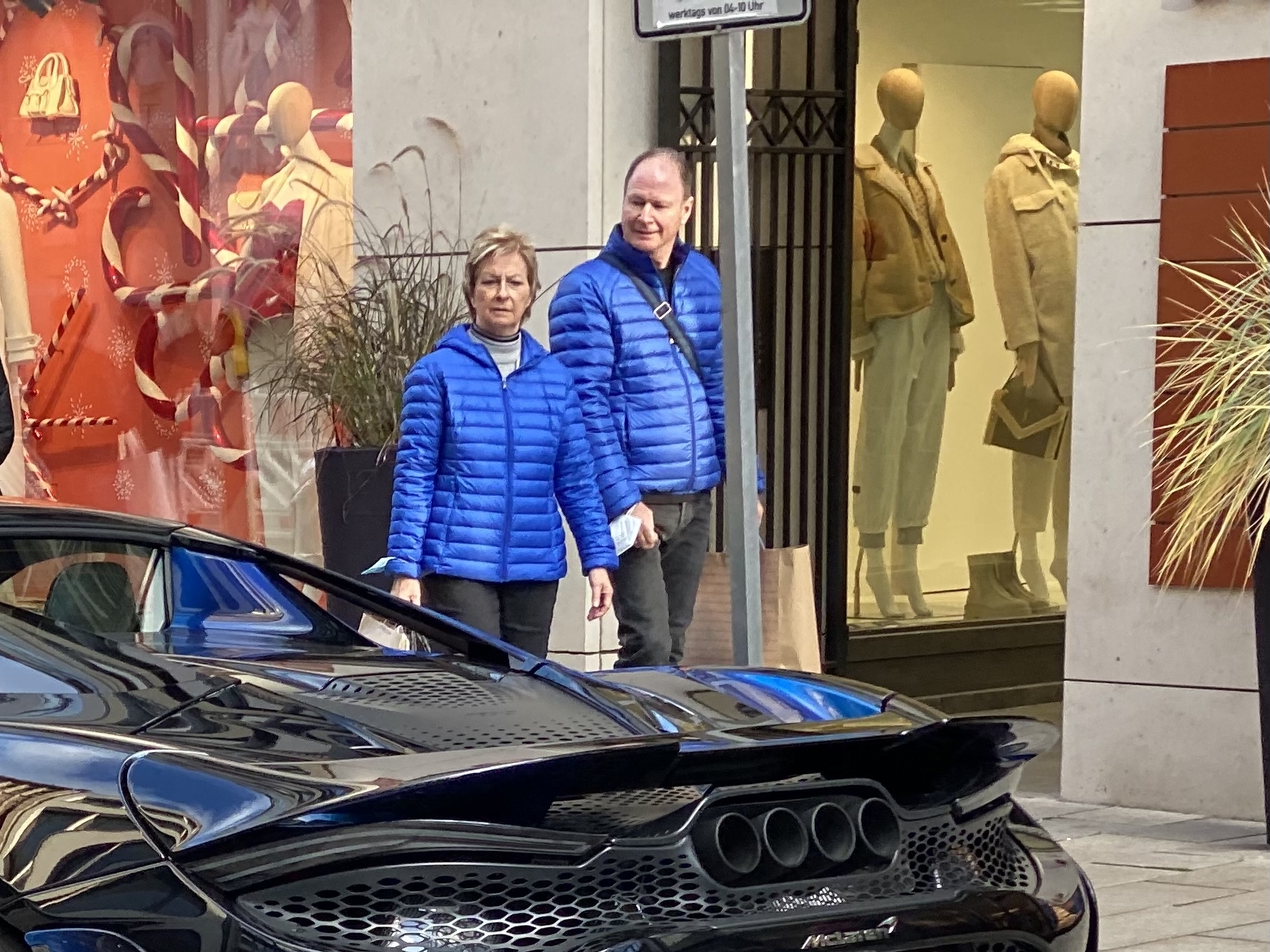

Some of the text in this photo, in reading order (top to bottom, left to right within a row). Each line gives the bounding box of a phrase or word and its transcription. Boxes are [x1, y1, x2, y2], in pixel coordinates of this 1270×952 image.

[668, 1, 764, 19] werktags von 04-10 Uhr
[800, 927, 890, 950] McLaren
